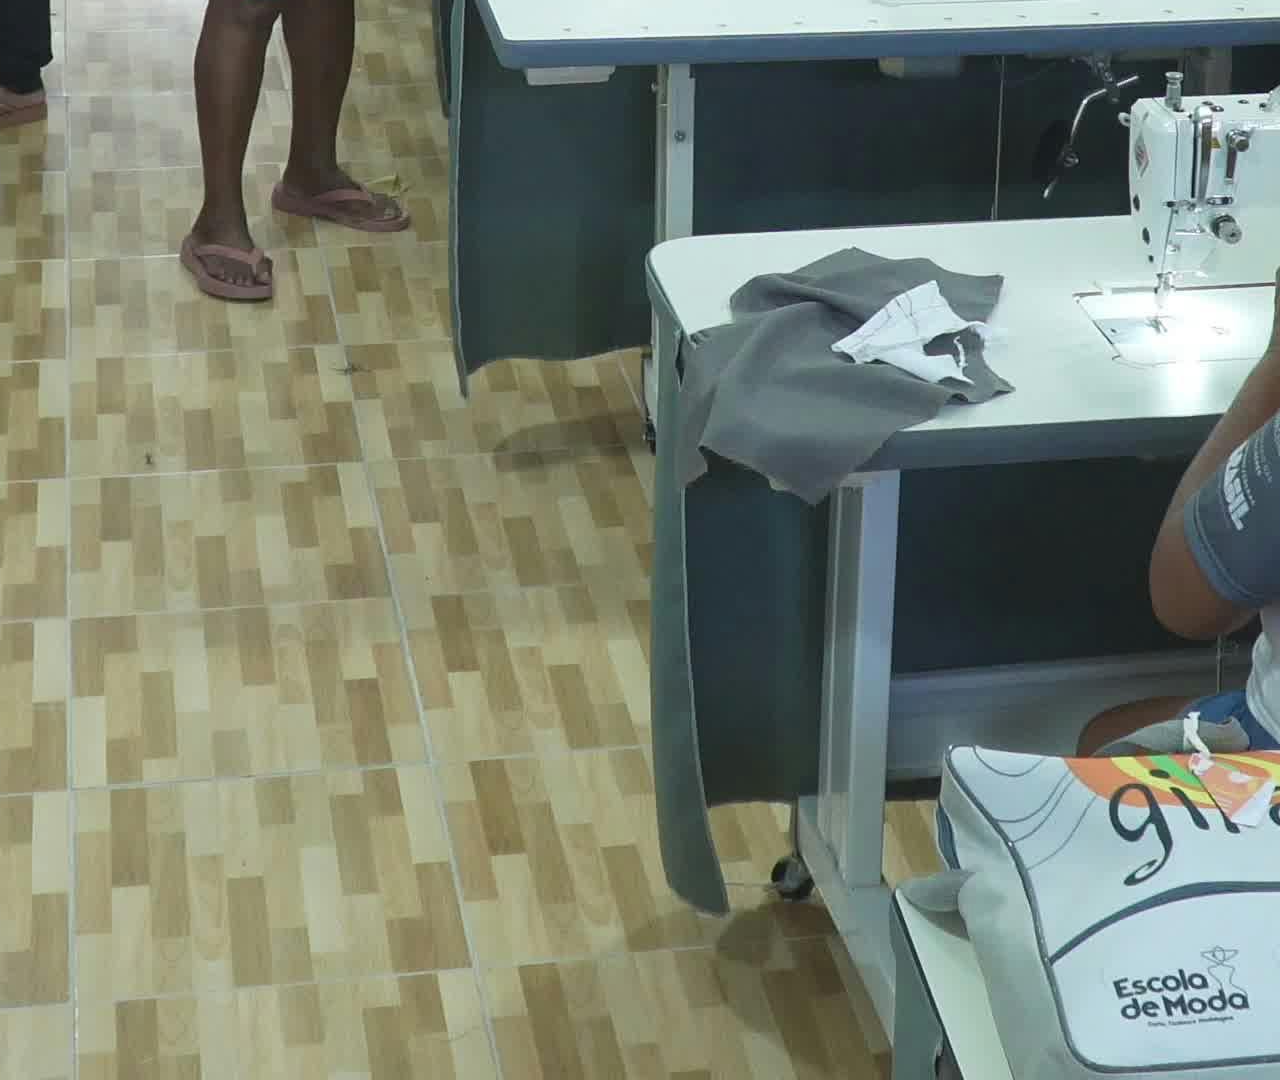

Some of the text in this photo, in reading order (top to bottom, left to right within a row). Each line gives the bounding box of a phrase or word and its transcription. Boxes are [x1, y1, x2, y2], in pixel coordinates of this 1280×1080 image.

[1112, 968, 1209, 1001] Escola
[1121, 987, 1250, 1020] de Moda
